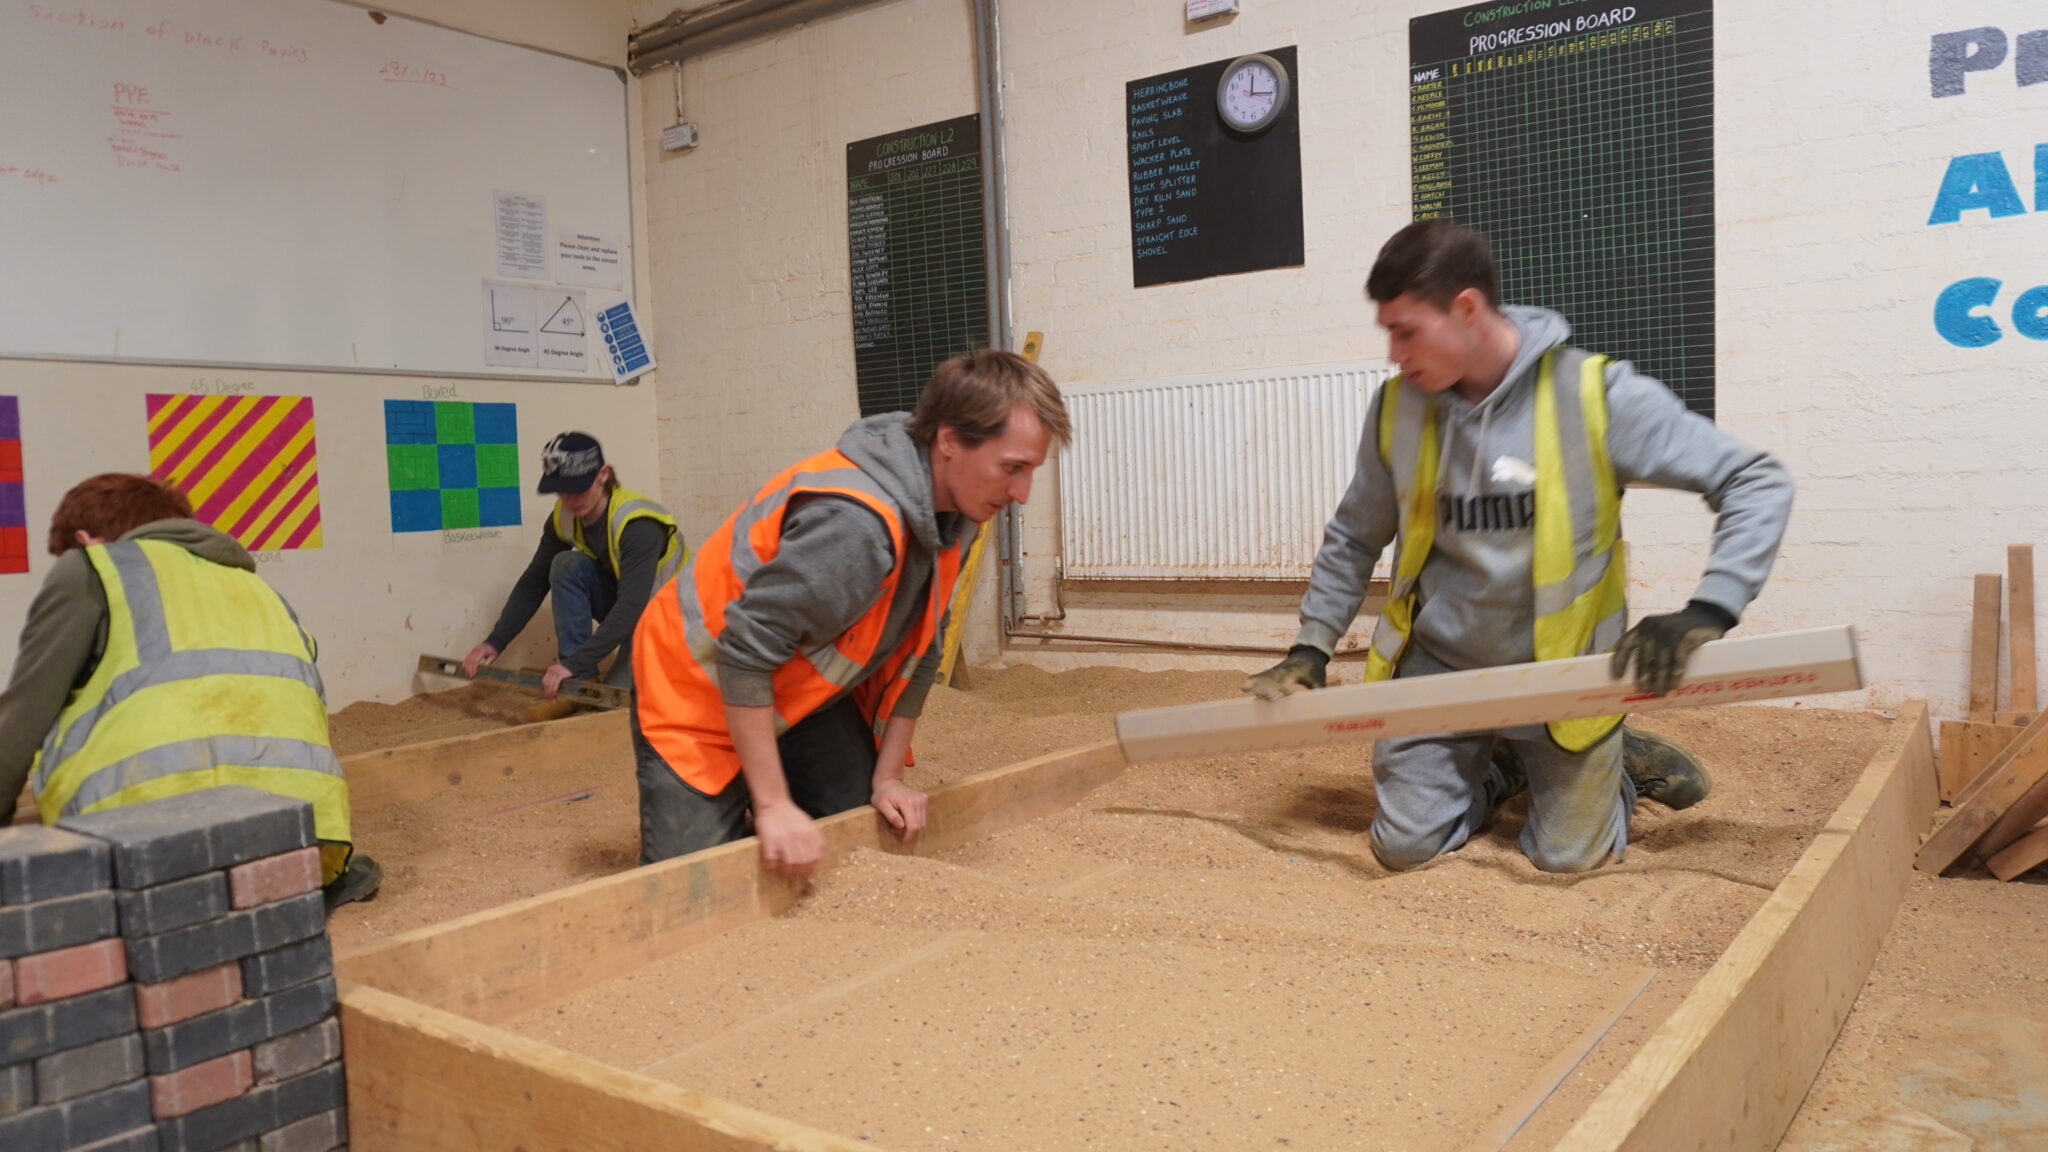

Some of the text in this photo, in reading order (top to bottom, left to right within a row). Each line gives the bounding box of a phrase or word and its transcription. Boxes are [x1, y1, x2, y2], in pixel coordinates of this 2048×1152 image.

[1463, 0, 1552, 27] CONSTRUCTION
[146, 19, 169, 39] of
[1470, 7, 1636, 56] PROGRESSION BOARD
[1414, 68, 1440, 83] NAME
[113, 82, 150, 104] PPE
[1133, 78, 1190, 98] HERRINGBONE
[1132, 92, 1189, 114] BASKETWEAVE
[1132, 108, 1182, 127] PAVING SLAB
[876, 128, 955, 157] CONSTRUCTION L2
[1132, 128, 1154, 140] RAILS
[1132, 135, 1182, 154] SPIRIT LEVEL
[868, 146, 948, 172] PROGRESSION BOARD
[1133, 147, 1192, 166] WACKER PLATE
[1133, 160, 1201, 182] RUBBER MALLET
[1134, 174, 1196, 194] BLOCK SPLITTER
[1134, 188, 1198, 208] DRY KILN SAND
[1136, 204, 1165, 218] TYPE 1
[1136, 214, 1188, 232] SHARP SAND
[577, 234, 600, 242] Attention
[1136, 227, 1198, 247] STRAIGHT EDGE
[1136, 246, 1168, 259] SHOVEL
[518, 346, 530, 354] Angle
[551, 349, 568, 357] Degree
[190, 378, 209, 392] 45
[422, 382, 458, 400] Boxed
